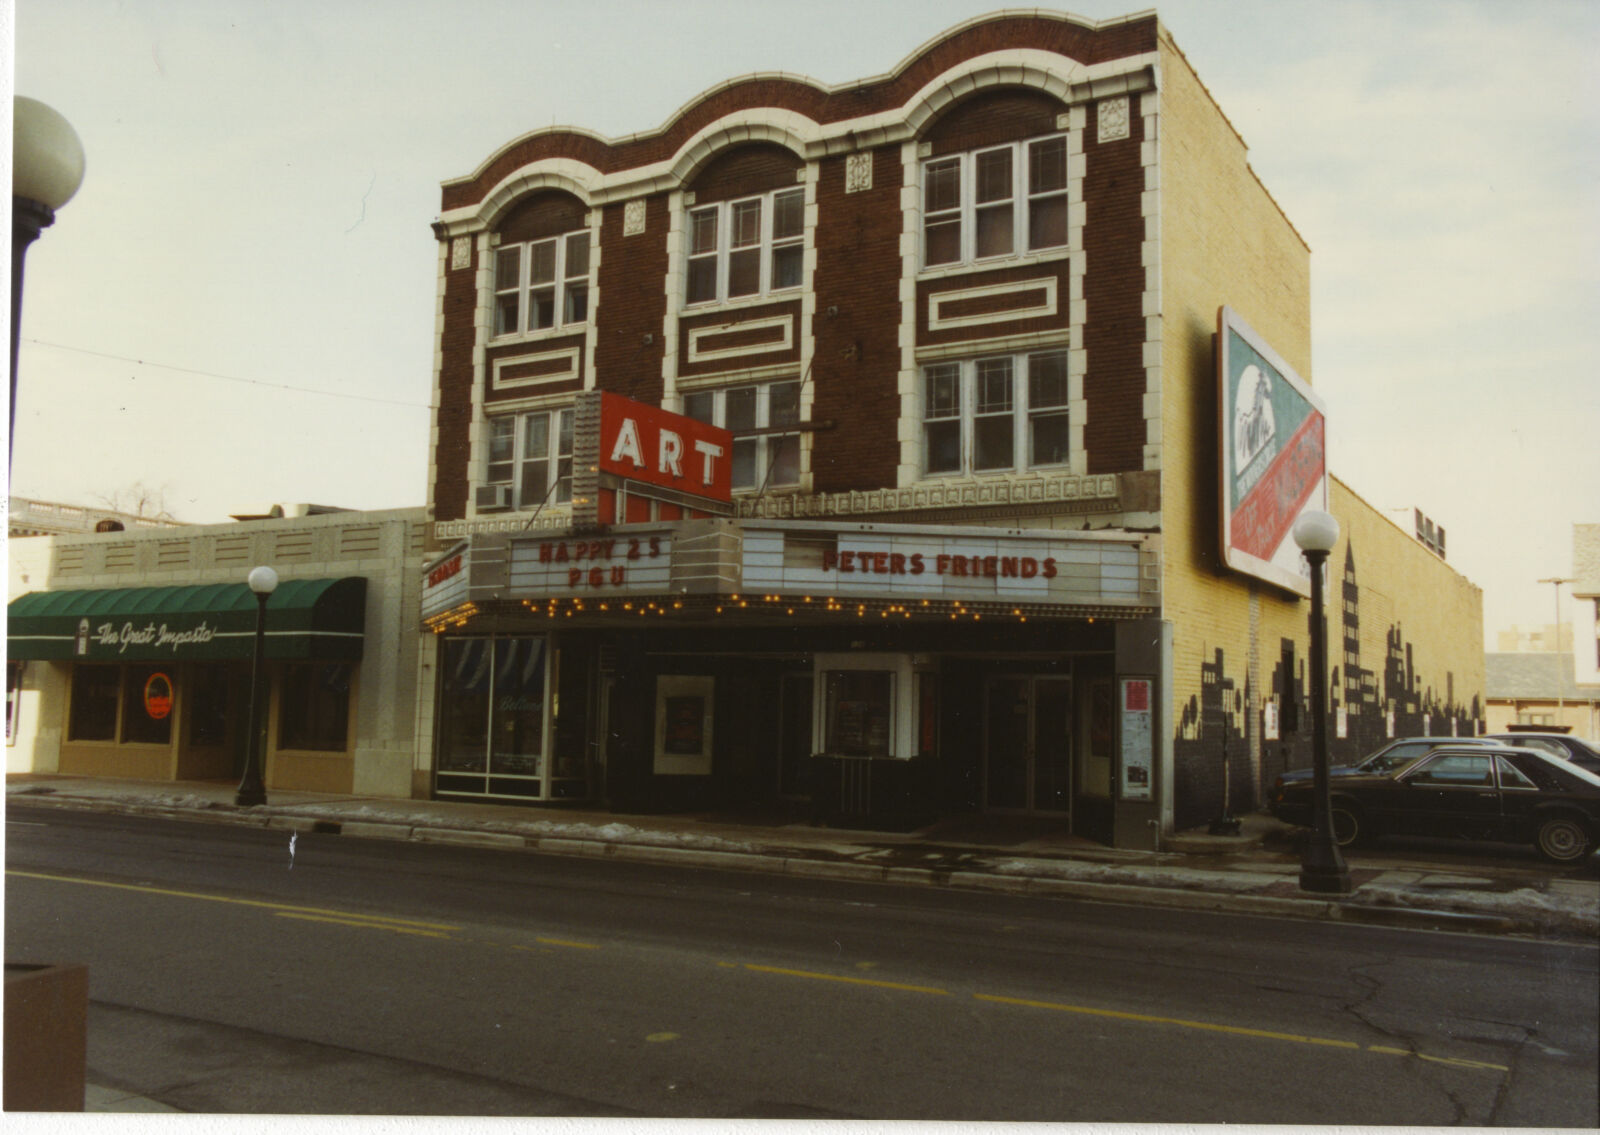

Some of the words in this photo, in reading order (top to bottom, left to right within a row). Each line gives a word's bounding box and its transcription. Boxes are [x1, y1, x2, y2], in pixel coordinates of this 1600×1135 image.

[610, 418, 724, 486] ART
[539, 538, 617, 563] HAPPY
[822, 551, 925, 575] PETERS
[936, 554, 1057, 579] FRIENDS
[98, 622, 119, 644] The
[119, 622, 156, 653] Great
[155, 621, 217, 652] Impasta
